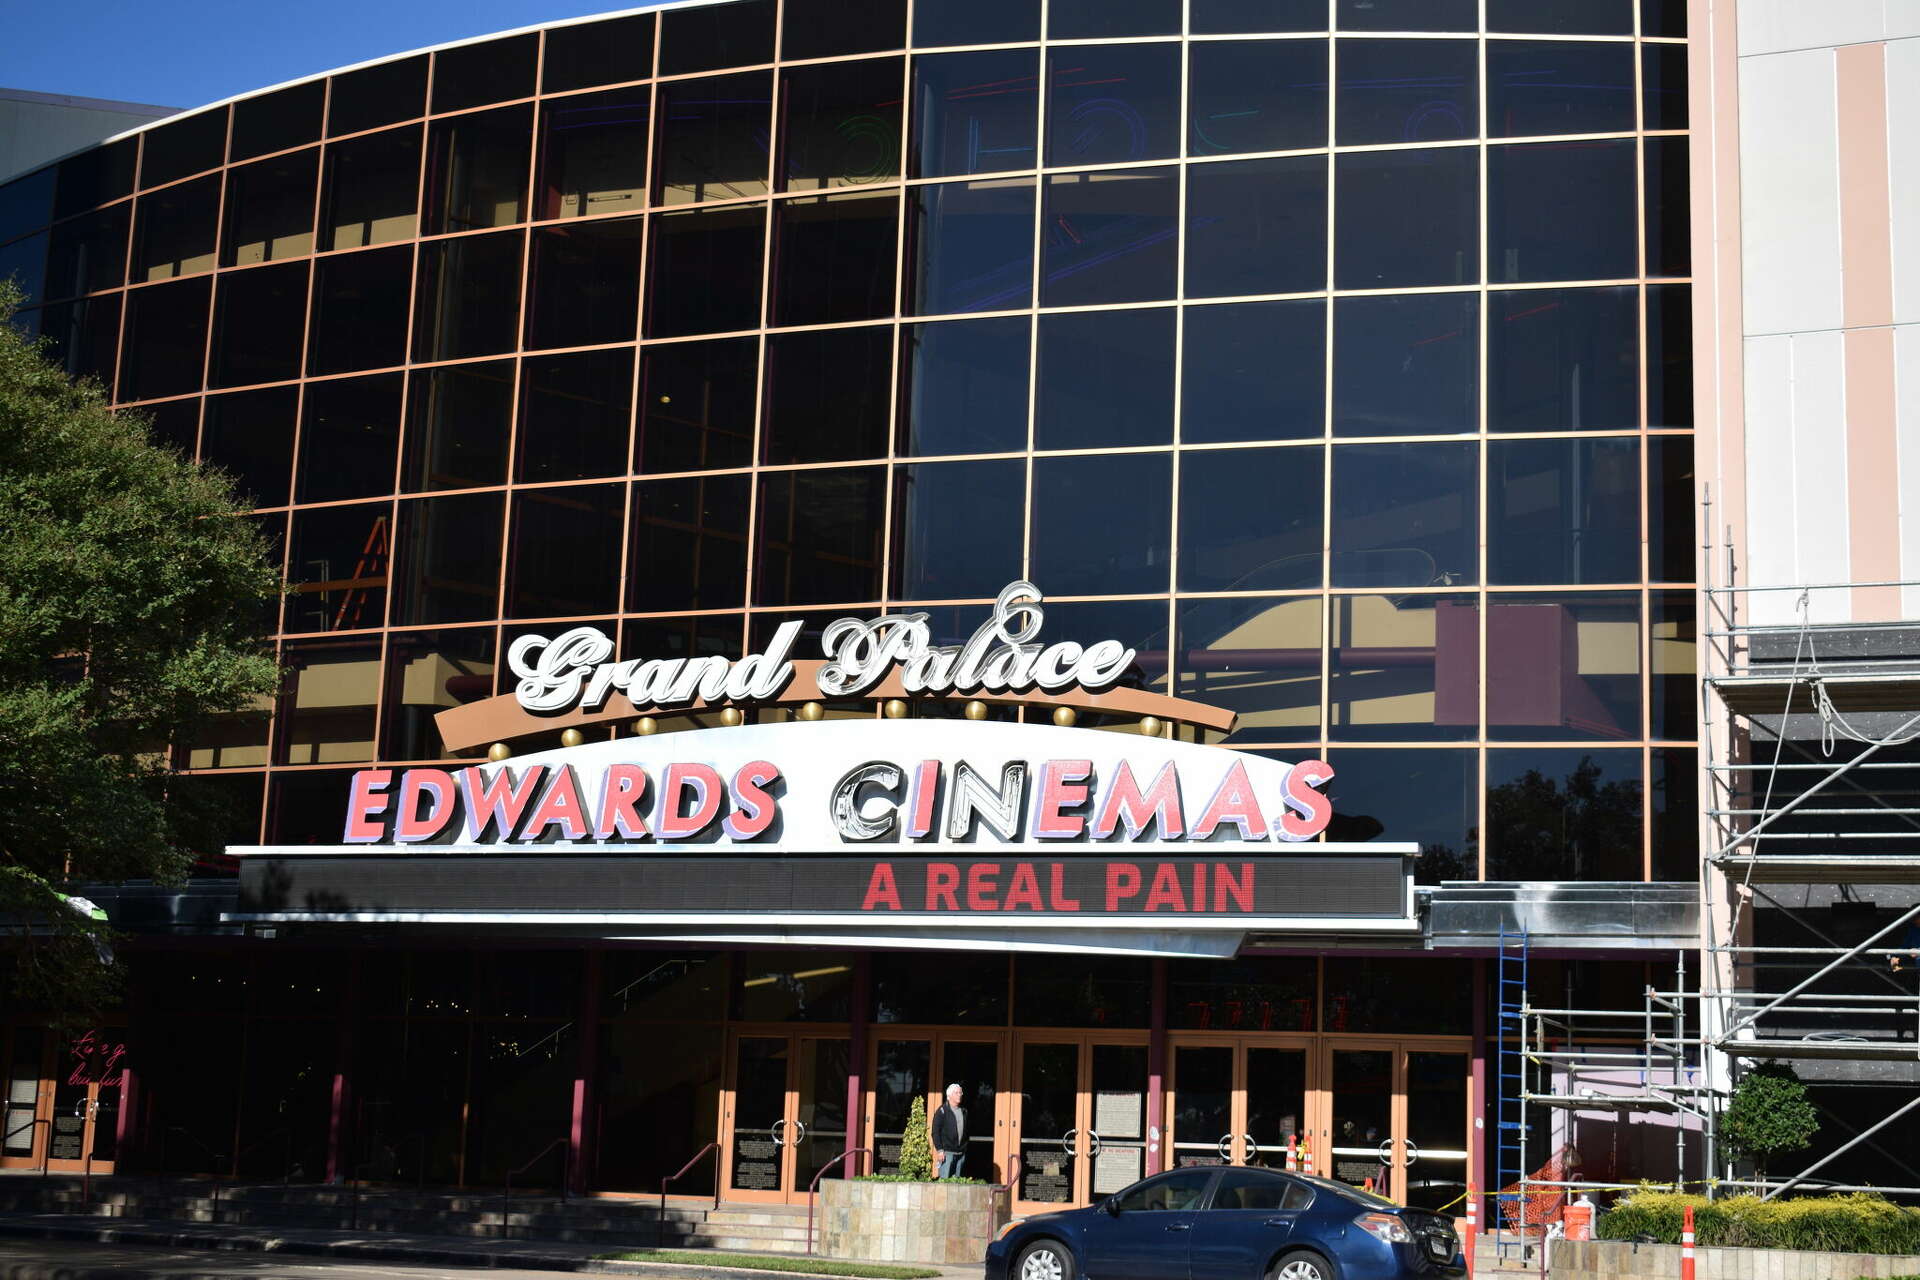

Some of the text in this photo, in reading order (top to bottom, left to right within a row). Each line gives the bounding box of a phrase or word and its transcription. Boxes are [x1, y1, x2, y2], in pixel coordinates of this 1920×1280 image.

[507, 579, 1136, 712] Grand Palace
[342, 758, 1335, 844] EDWARDS CINEMAS
[861, 862, 1256, 912] A REAL PAIN
